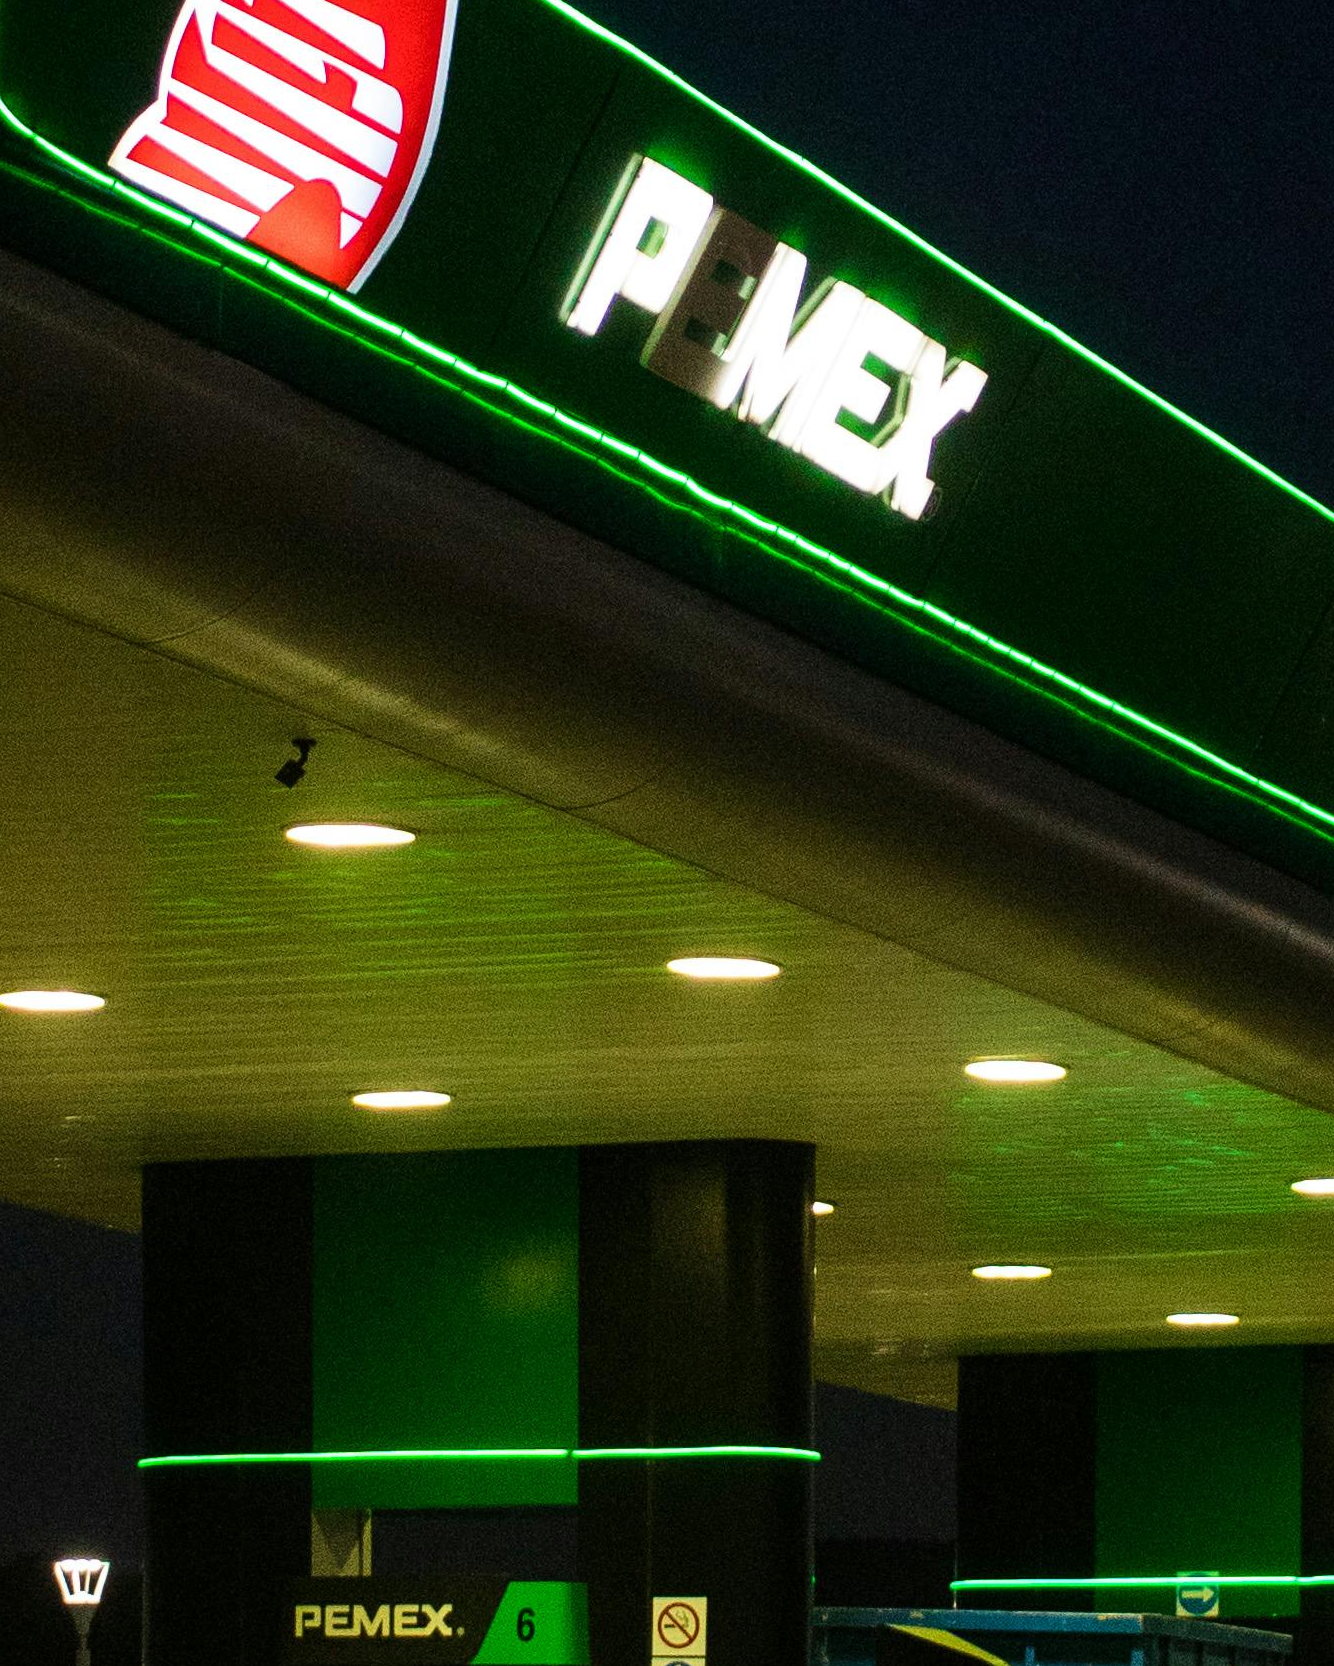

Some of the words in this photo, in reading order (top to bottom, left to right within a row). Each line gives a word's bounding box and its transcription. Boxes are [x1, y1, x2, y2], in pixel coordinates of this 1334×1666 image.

[559, 152, 988, 521] PEMEX
[293, 1603, 455, 1639] PEMEX
[516, 1608, 535, 1643] 6
